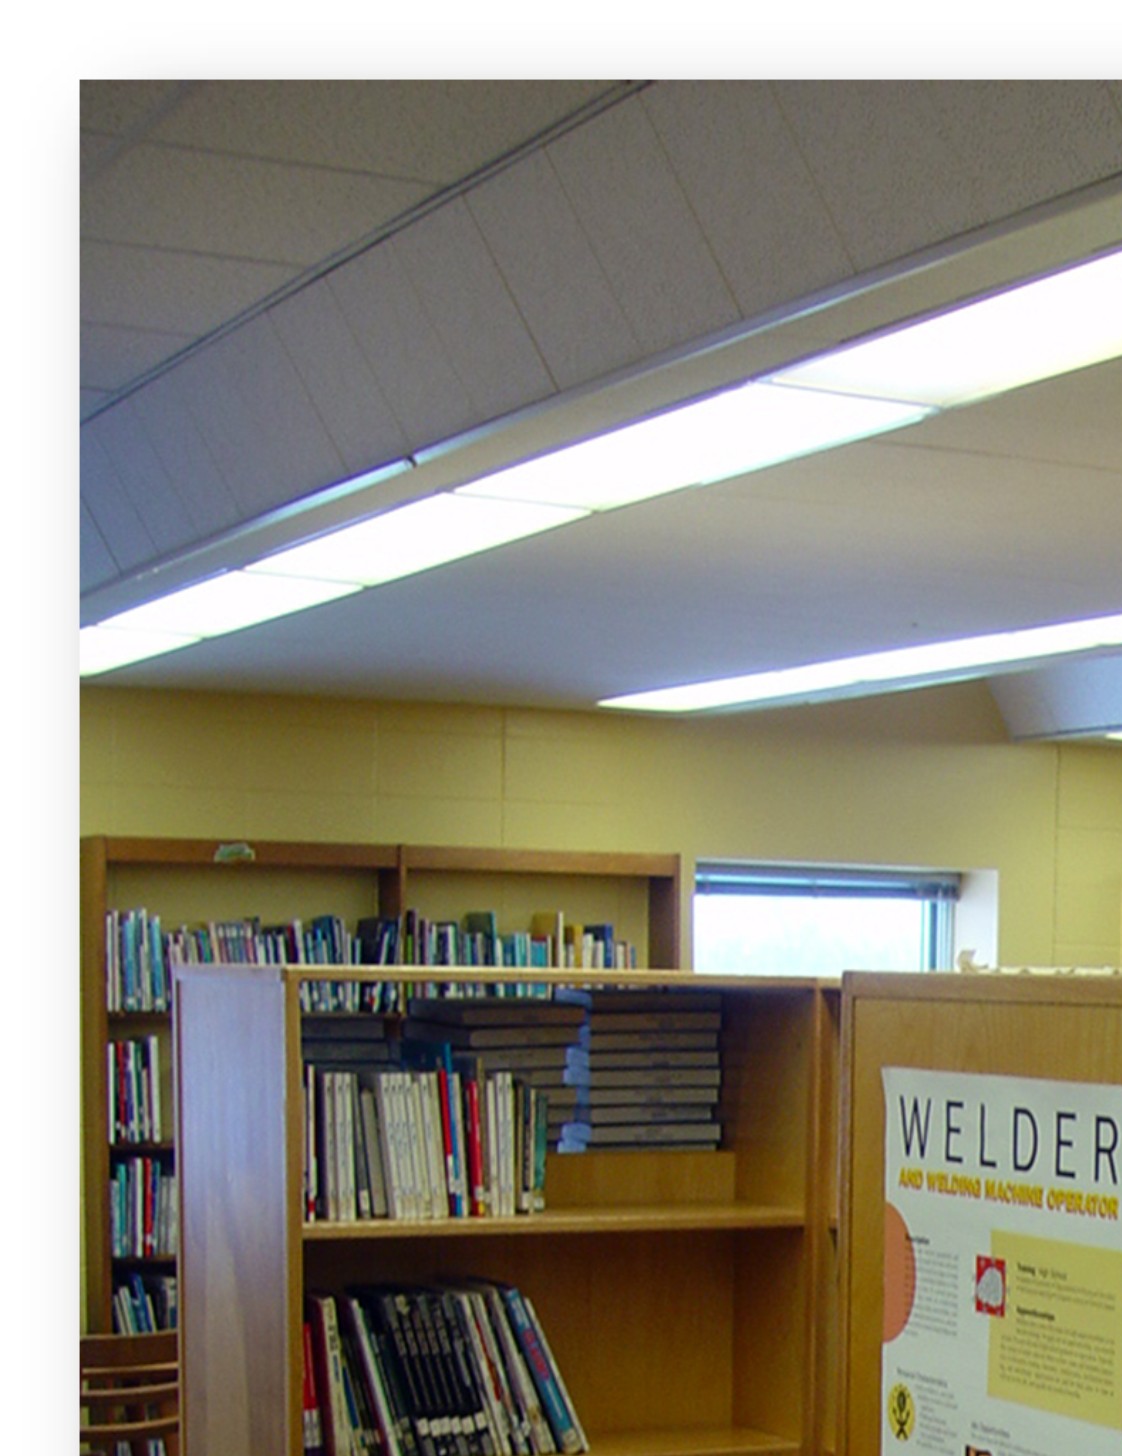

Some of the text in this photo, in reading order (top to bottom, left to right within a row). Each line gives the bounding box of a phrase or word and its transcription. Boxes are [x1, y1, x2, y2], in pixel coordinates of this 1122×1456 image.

[900, 1094, 1119, 1186] WELDER
[899, 1167, 1119, 1221] AND WELDING MACHINE OPERATOR
